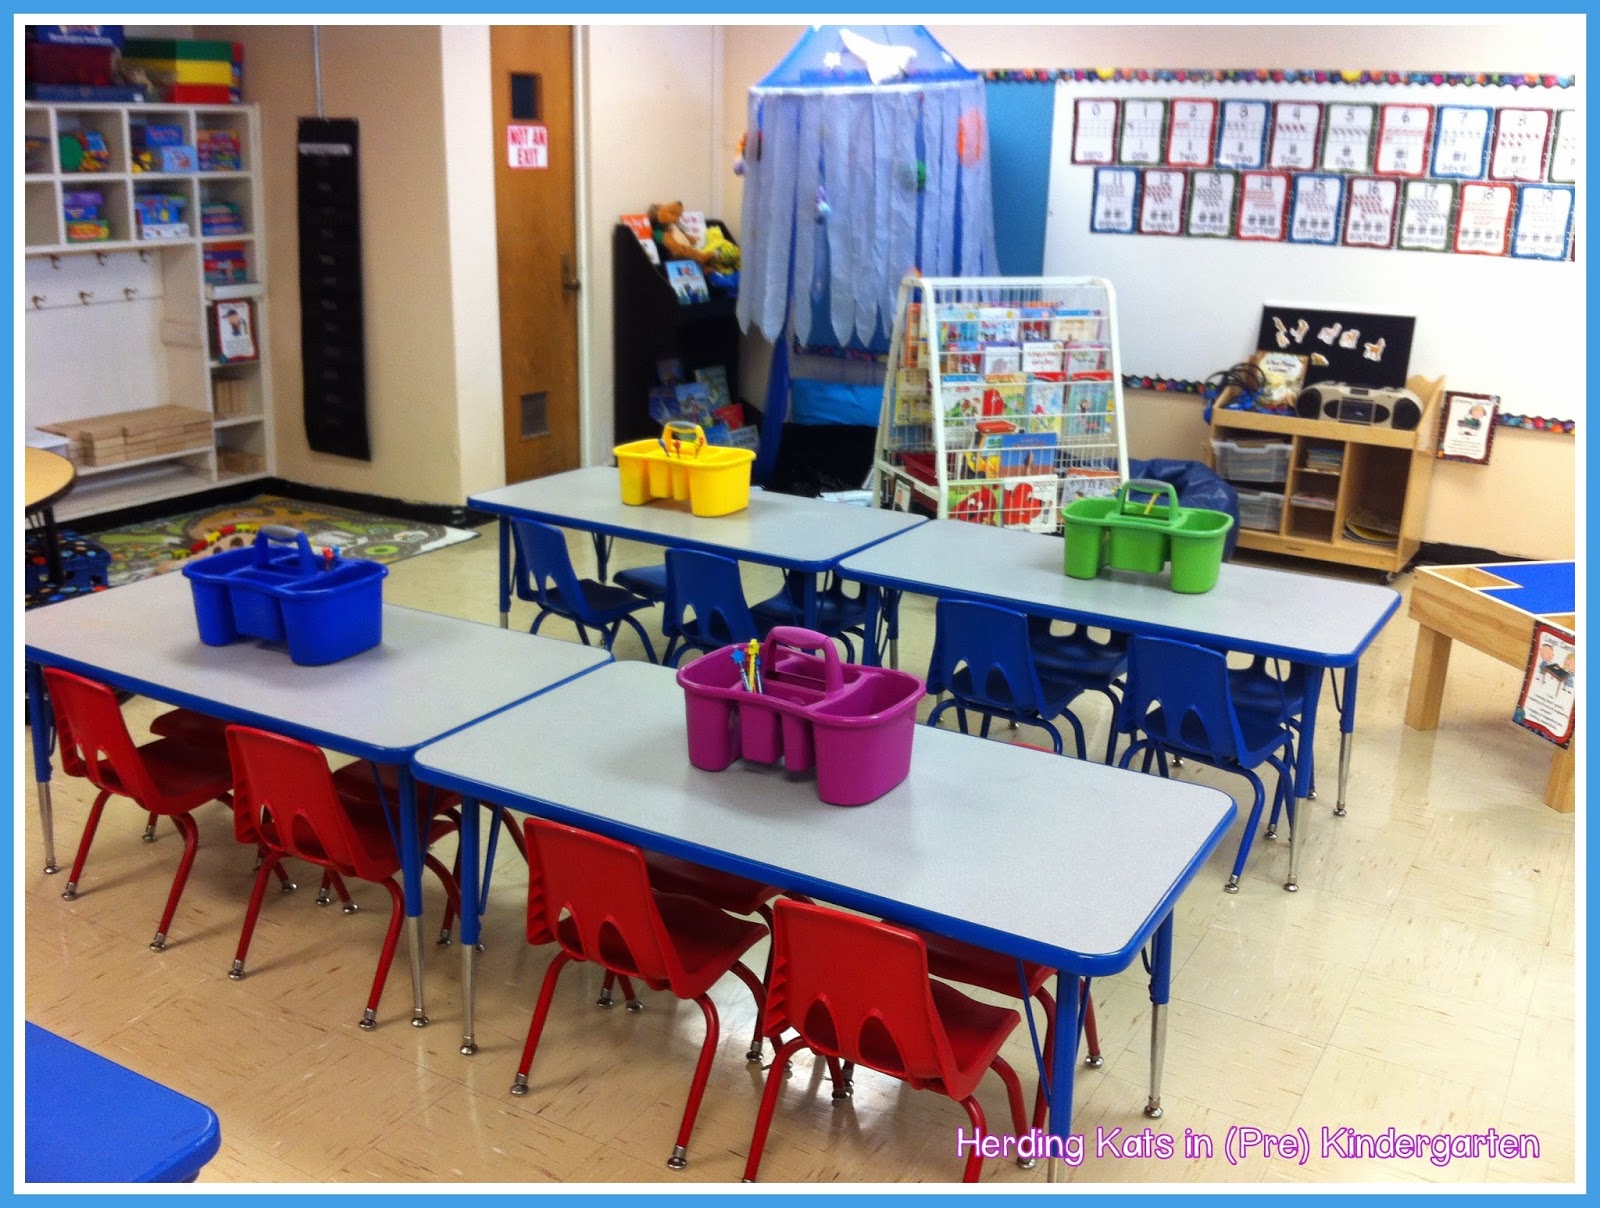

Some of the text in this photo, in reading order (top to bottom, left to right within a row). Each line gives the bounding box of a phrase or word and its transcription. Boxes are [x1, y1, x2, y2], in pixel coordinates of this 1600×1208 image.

[1091, 104, 1101, 116] 0
[1189, 105, 1198, 118] 2
[1345, 107, 1355, 122] 5
[1401, 110, 1411, 123] 6
[1459, 111, 1468, 125] 7
[510, 128, 546, 146] NOT AN
[517, 147, 538, 166] EXIT
[1159, 172, 1171, 186] 12
[1260, 176, 1273, 190] 14
[1313, 180, 1326, 194] 15
[1367, 180, 1380, 195] 16
[1424, 183, 1438, 199] 17
